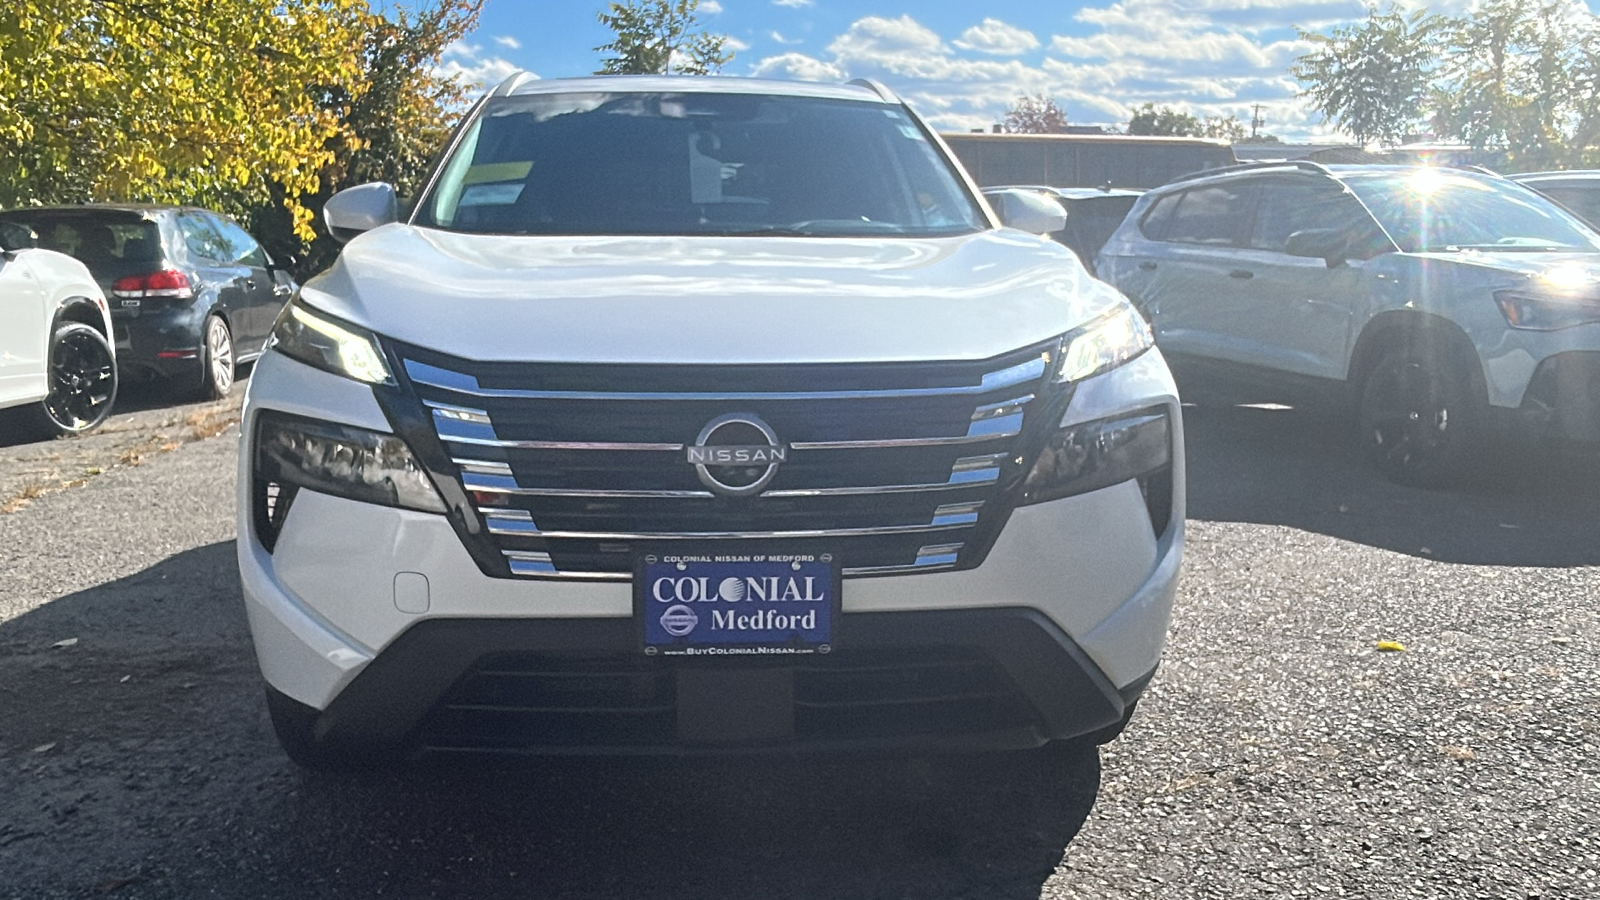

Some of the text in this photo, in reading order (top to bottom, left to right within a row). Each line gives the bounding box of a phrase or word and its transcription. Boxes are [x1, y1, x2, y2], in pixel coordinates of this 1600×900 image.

[690, 448, 785, 461] NISSAN
[663, 555, 712, 563] COLONIAL
[714, 555, 750, 563] NISSAN
[768, 554, 815, 562] MEDFORD
[652, 576, 824, 602] COLONIAL
[711, 609, 816, 630] Medford
